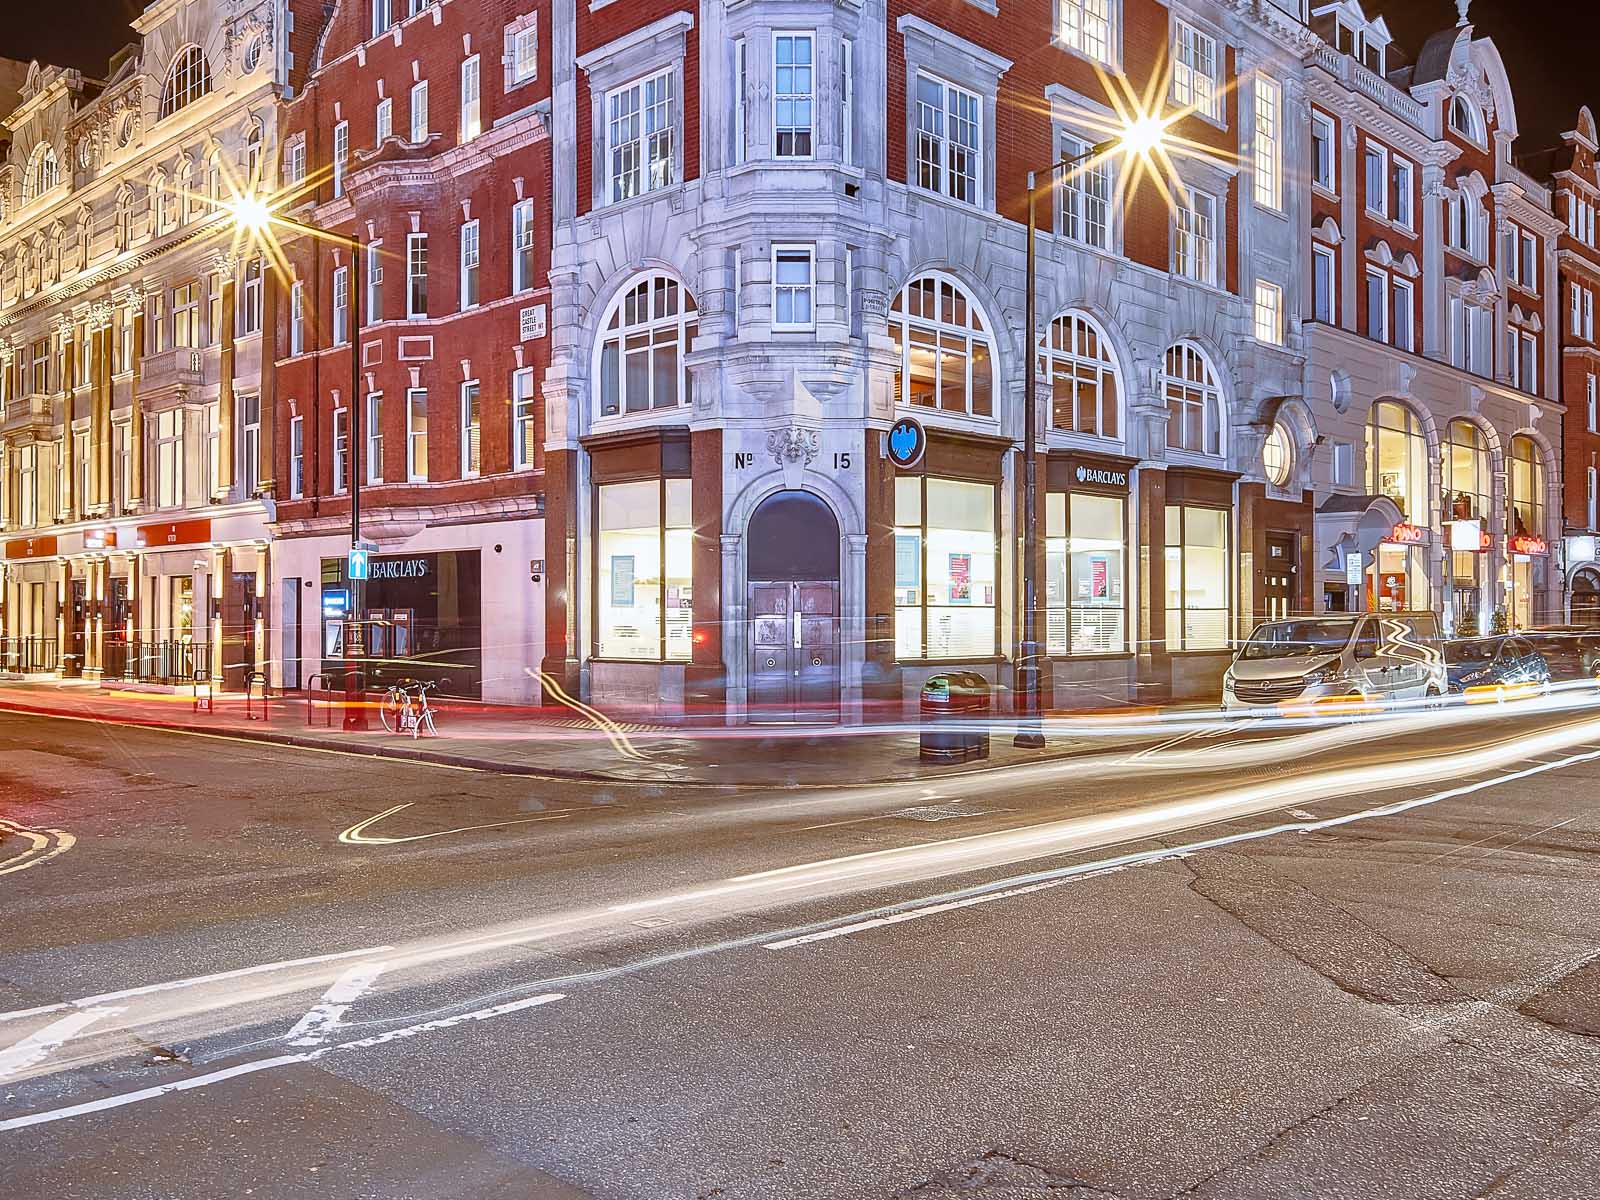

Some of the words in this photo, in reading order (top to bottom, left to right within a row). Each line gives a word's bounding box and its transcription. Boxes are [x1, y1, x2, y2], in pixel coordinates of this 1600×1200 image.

[522, 309, 535, 318] GREAT
[522, 316, 537, 326] CASTLE
[522, 324, 537, 334] STREET
[833, 452, 851, 470] 15
[1086, 468, 1126, 486] BARCLAYS
[373, 559, 425, 579] BARCLAYS
